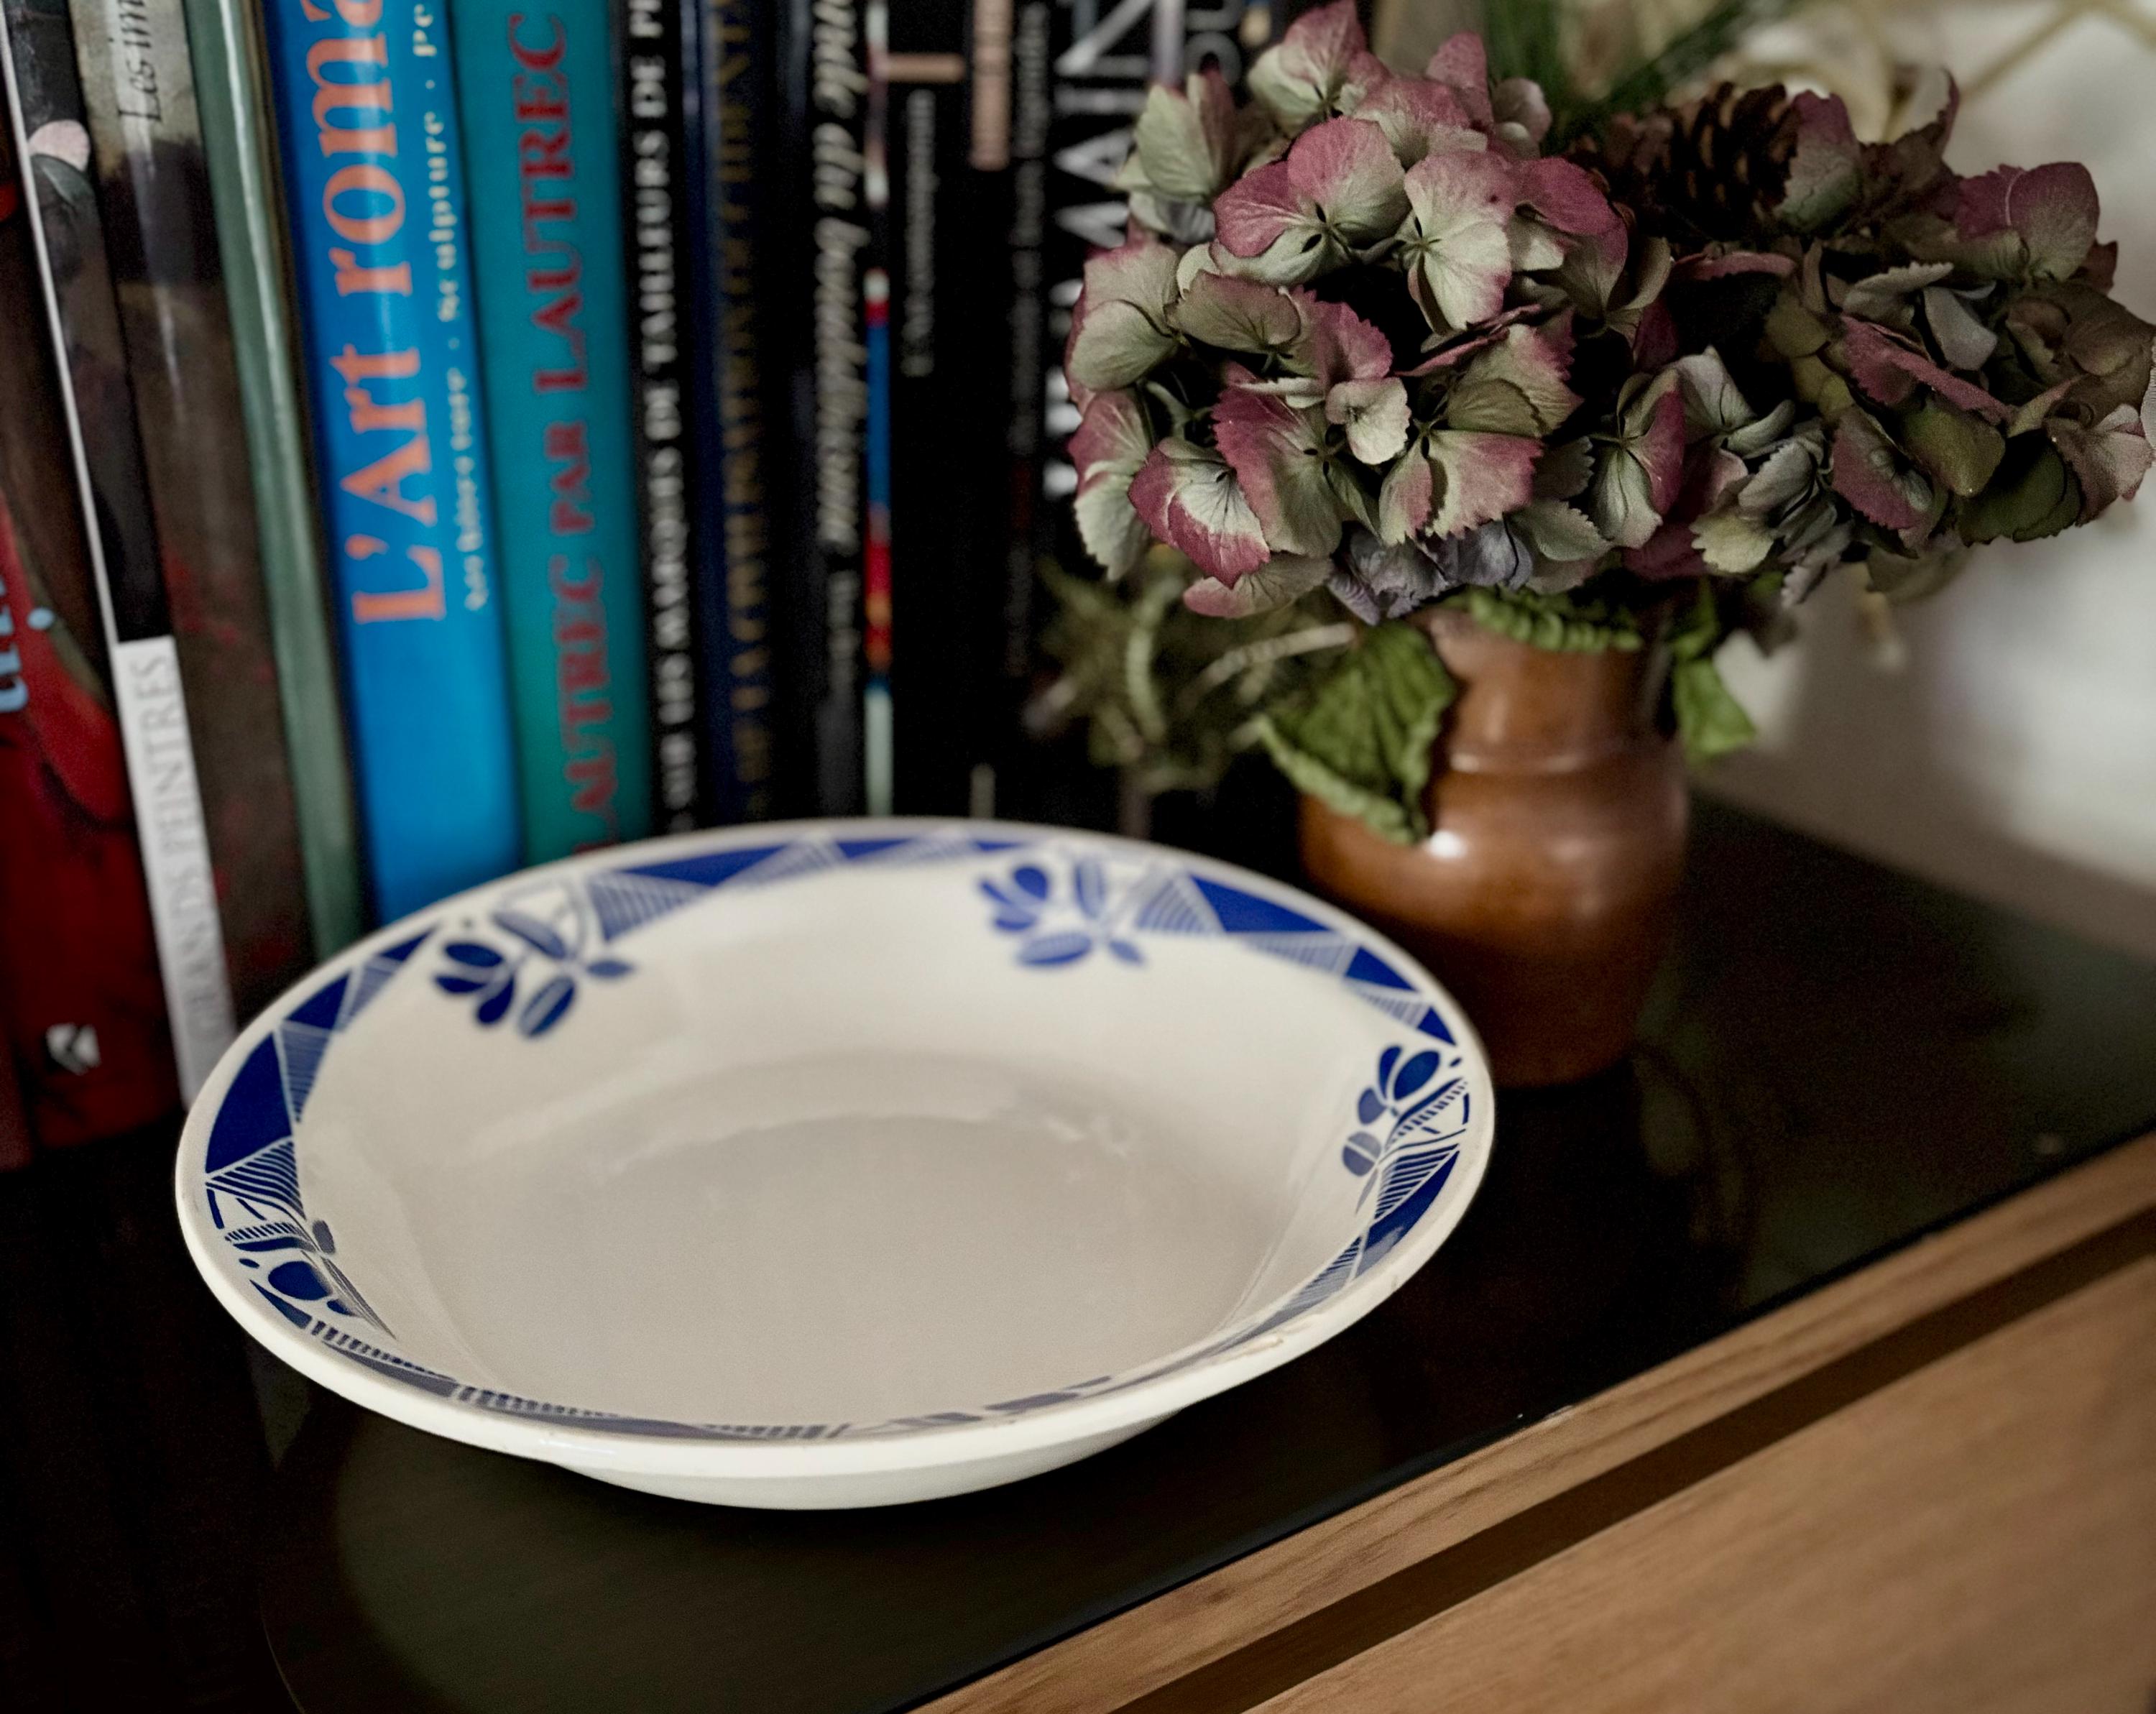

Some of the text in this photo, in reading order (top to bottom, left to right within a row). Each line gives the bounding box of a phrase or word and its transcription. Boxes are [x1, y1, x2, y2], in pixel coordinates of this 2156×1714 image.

[116, 58, 162, 123] Les
[631, 55, 667, 118] DE
[423, 111, 461, 322] Sculpture
[508, 14, 588, 392] LAUTREC
[633, 131, 677, 372] TAILLEURS
[328, 344, 447, 624] L'Art
[544, 420, 594, 535] PAR
[644, 379, 682, 440] DE
[135, 653, 205, 859] PEINTRES
